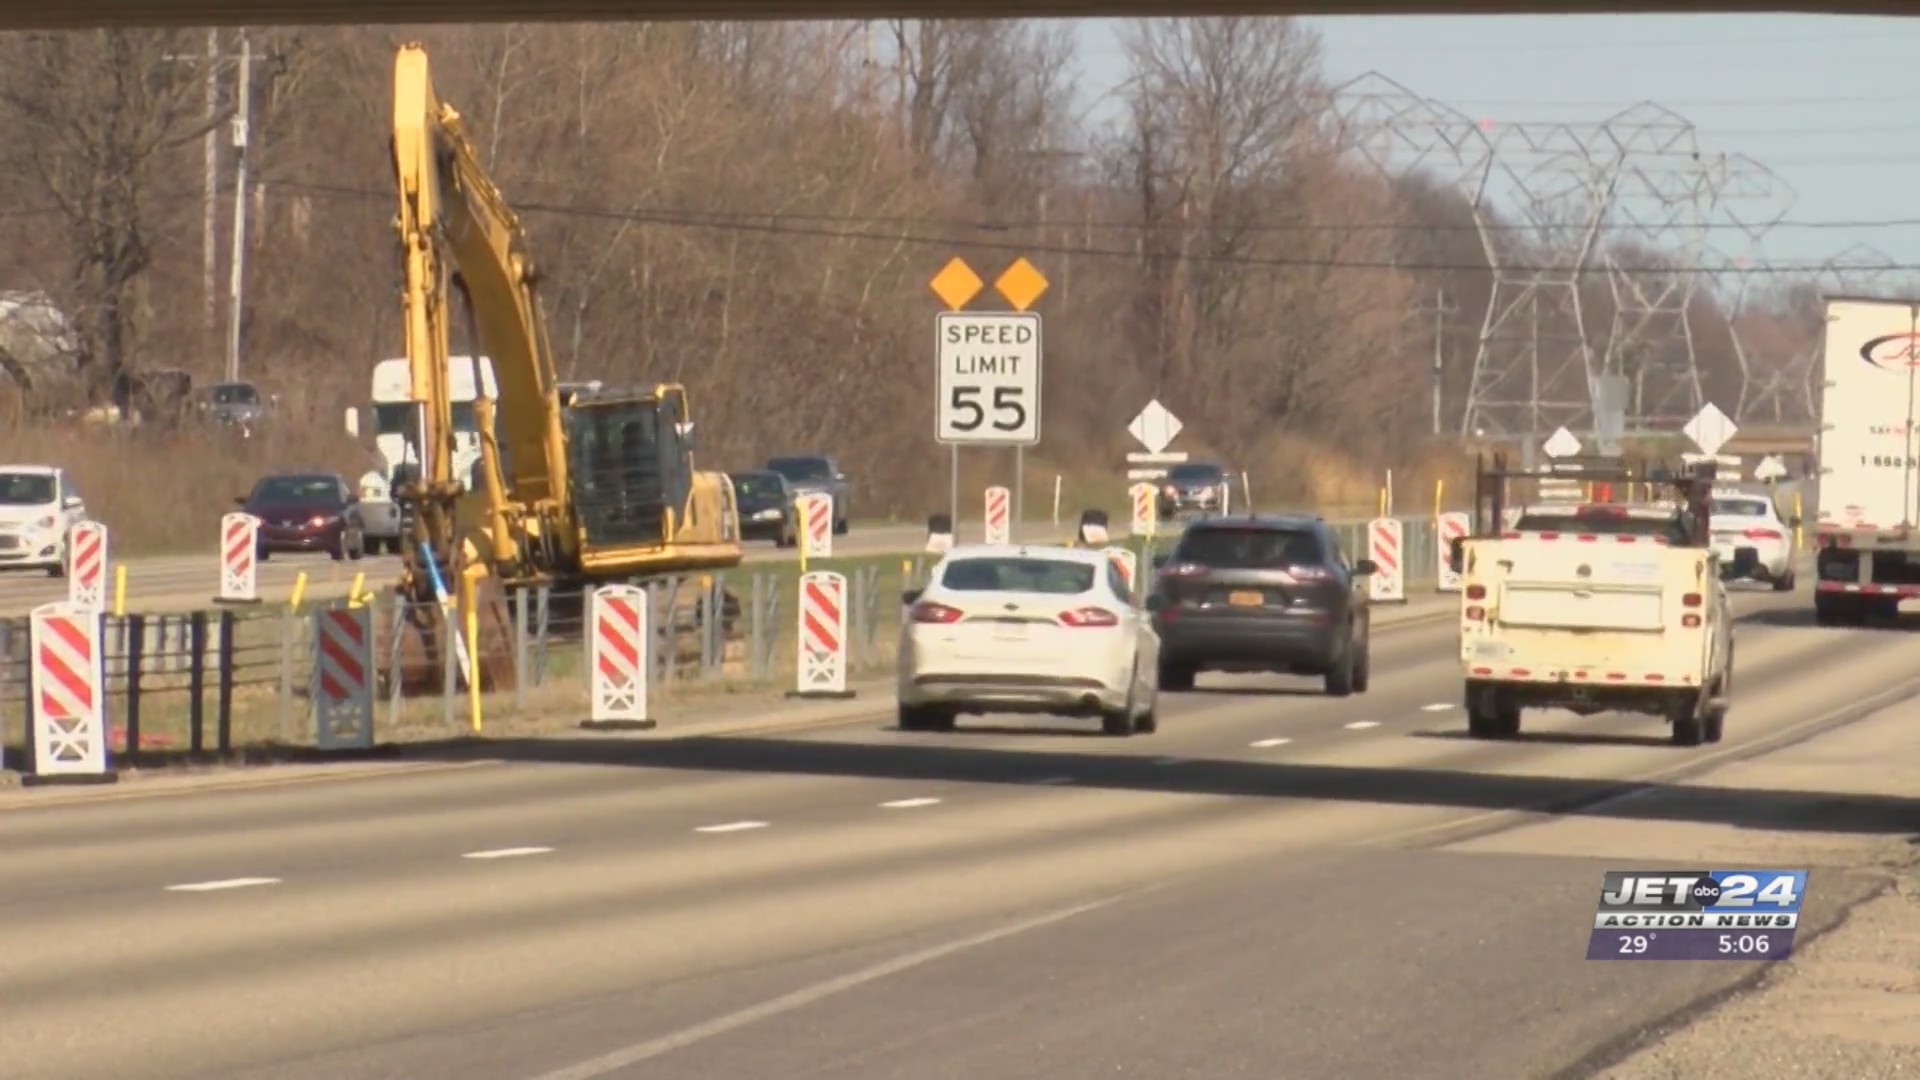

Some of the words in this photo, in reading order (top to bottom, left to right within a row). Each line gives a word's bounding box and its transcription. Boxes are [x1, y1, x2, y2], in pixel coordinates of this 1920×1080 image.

[947, 325, 1032, 344] SPEED
[956, 355, 1022, 374] LIMIT
[950, 386, 1026, 432] 55
